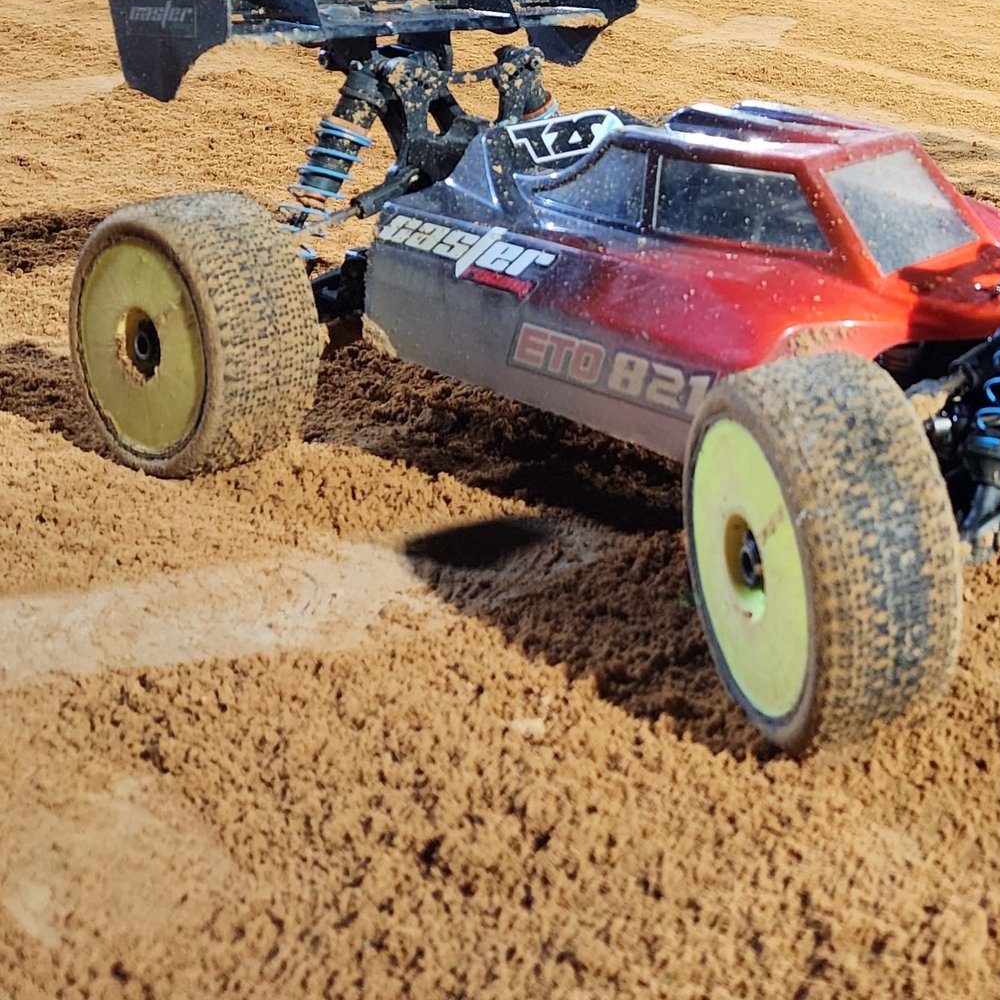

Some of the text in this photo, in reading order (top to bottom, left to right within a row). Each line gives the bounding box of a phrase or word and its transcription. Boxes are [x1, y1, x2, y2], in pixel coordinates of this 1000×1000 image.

[379, 214, 556, 278] caster
[513, 322, 711, 415] ETO 821
